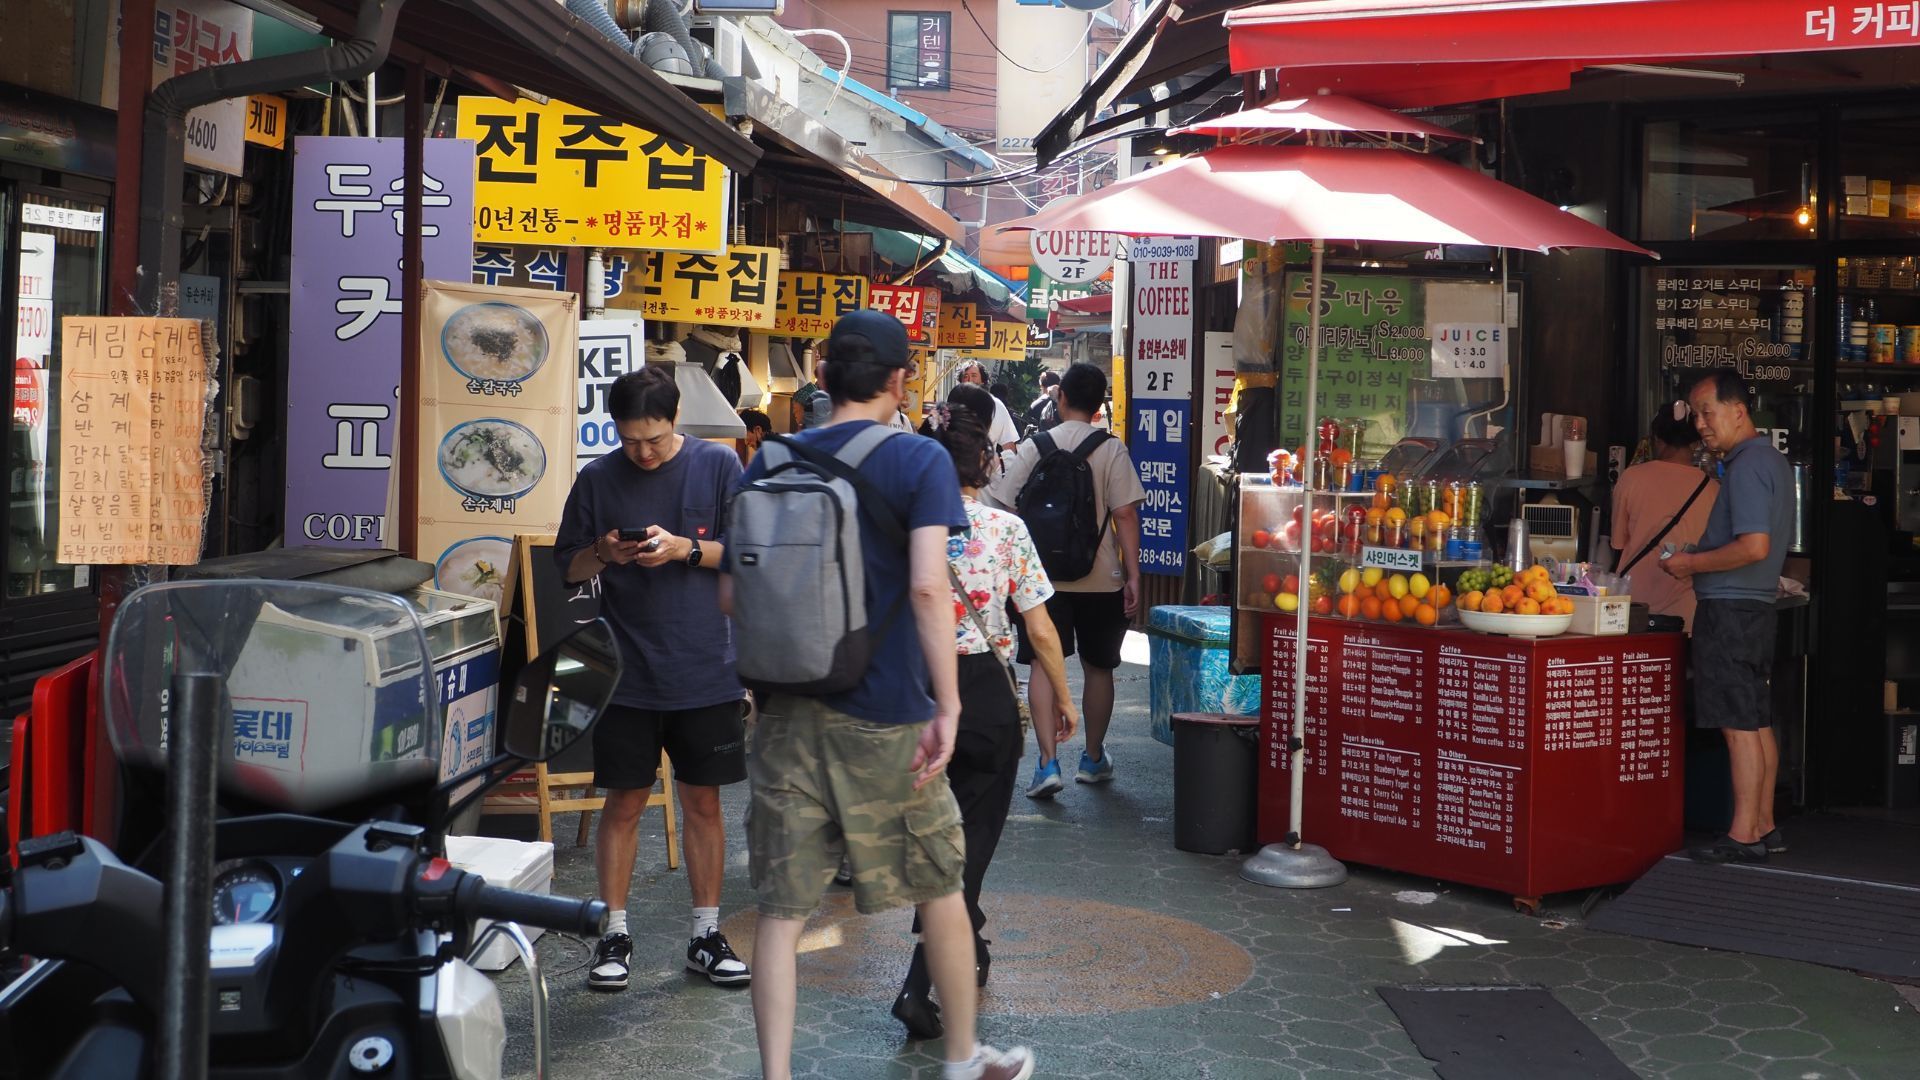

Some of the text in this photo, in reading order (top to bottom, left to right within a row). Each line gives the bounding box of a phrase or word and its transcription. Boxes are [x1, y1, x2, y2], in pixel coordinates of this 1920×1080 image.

[1805, 1, 1920, 41] 더 커피
[249, 100, 278, 138] 커피
[187, 117, 217, 151] 4600
[476, 112, 706, 191] 전주집
[314, 164, 451, 237] 두손
[1036, 230, 1111, 256] COFFEE
[1133, 245, 1194, 258] 010-9039-1088
[1149, 262, 1179, 280] THE
[1656, 278, 1804, 291] 플레인 요거트 스무디 3.5
[1138, 287, 1189, 315] COFFEE
[1656, 298, 1678, 310] 딸기
[1681, 298, 1714, 310] 요거트
[1717, 298, 1750, 310] 스무디
[785, 317, 834, 333] 생선구이
[1655, 318, 1698, 331] 블루베리
[1701, 318, 1735, 330] 요거트
[1738, 318, 1771, 331] 스무디
[1440, 329, 1500, 342] JUICE
[1470, 347, 1486, 356] 3.0
[1664, 344, 1736, 368] 아메리카노
[1470, 361, 1486, 369] 4.0
[1755, 366, 1791, 380] 3.000
[466, 379, 522, 397] 손칼국수
[1139, 410, 1183, 443] 제일
[1140, 461, 1176, 484] 열재단
[461, 497, 516, 514] 손수제비
[1141, 489, 1182, 512] 이야스
[1142, 517, 1172, 537] 전문
[1366, 550, 1419, 569] 샤인머스켓
[1274, 627, 1299, 637] Fruit Jui
[1440, 645, 1461, 654] Coffee
[1548, 658, 1565, 666] Coffee
